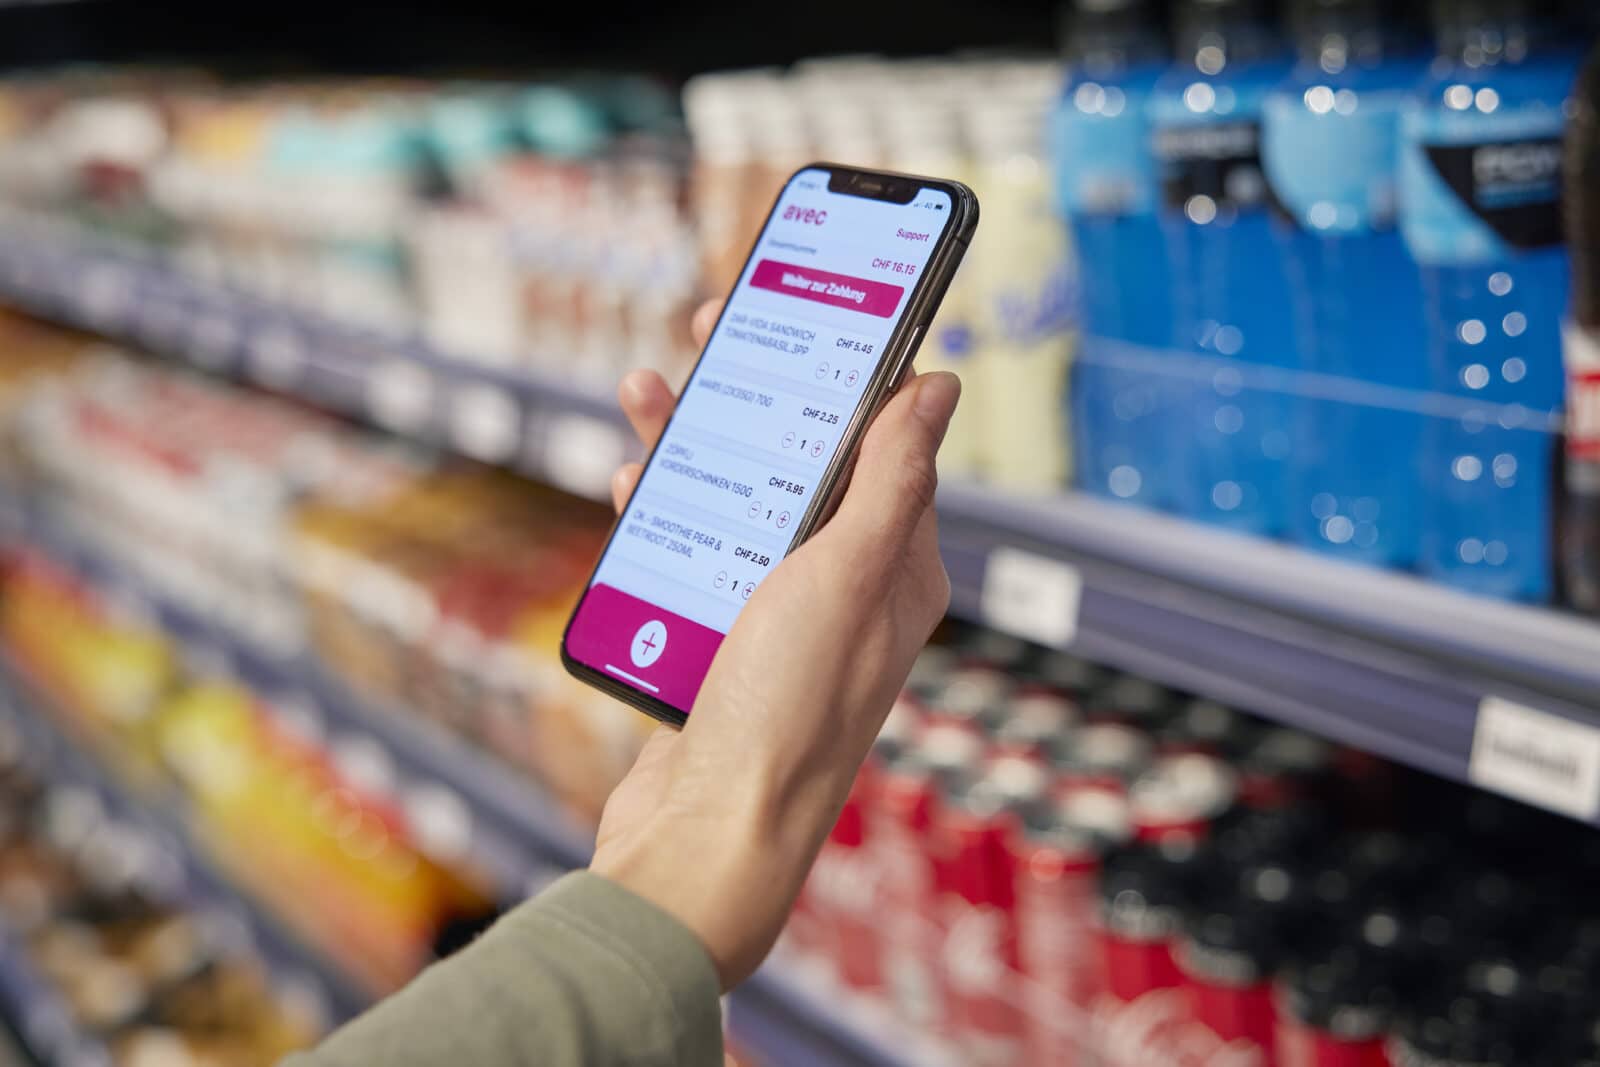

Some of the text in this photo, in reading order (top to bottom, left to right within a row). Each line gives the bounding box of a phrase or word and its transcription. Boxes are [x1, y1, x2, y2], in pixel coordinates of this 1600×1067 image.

[783, 204, 828, 225] avec
[896, 228, 931, 242] Support
[872, 258, 917, 276] CHF 16.15
[826, 282, 867, 304] Zahlung
[769, 322, 817, 342] SANDWICH
[836, 338, 874, 354] CHF 5.45
[834, 370, 841, 380] 1
[802, 407, 839, 425] CHF 2.25
[800, 439, 807, 449] 1
[731, 482, 753, 498] 150G
[768, 476, 805, 496] CHF 5.95
[766, 510, 773, 520] 1
[692, 532, 716, 549] PEAR
[714, 540, 722, 552] &
[735, 547, 770, 567] CHF 2.50
[731, 580, 738, 591] 1
